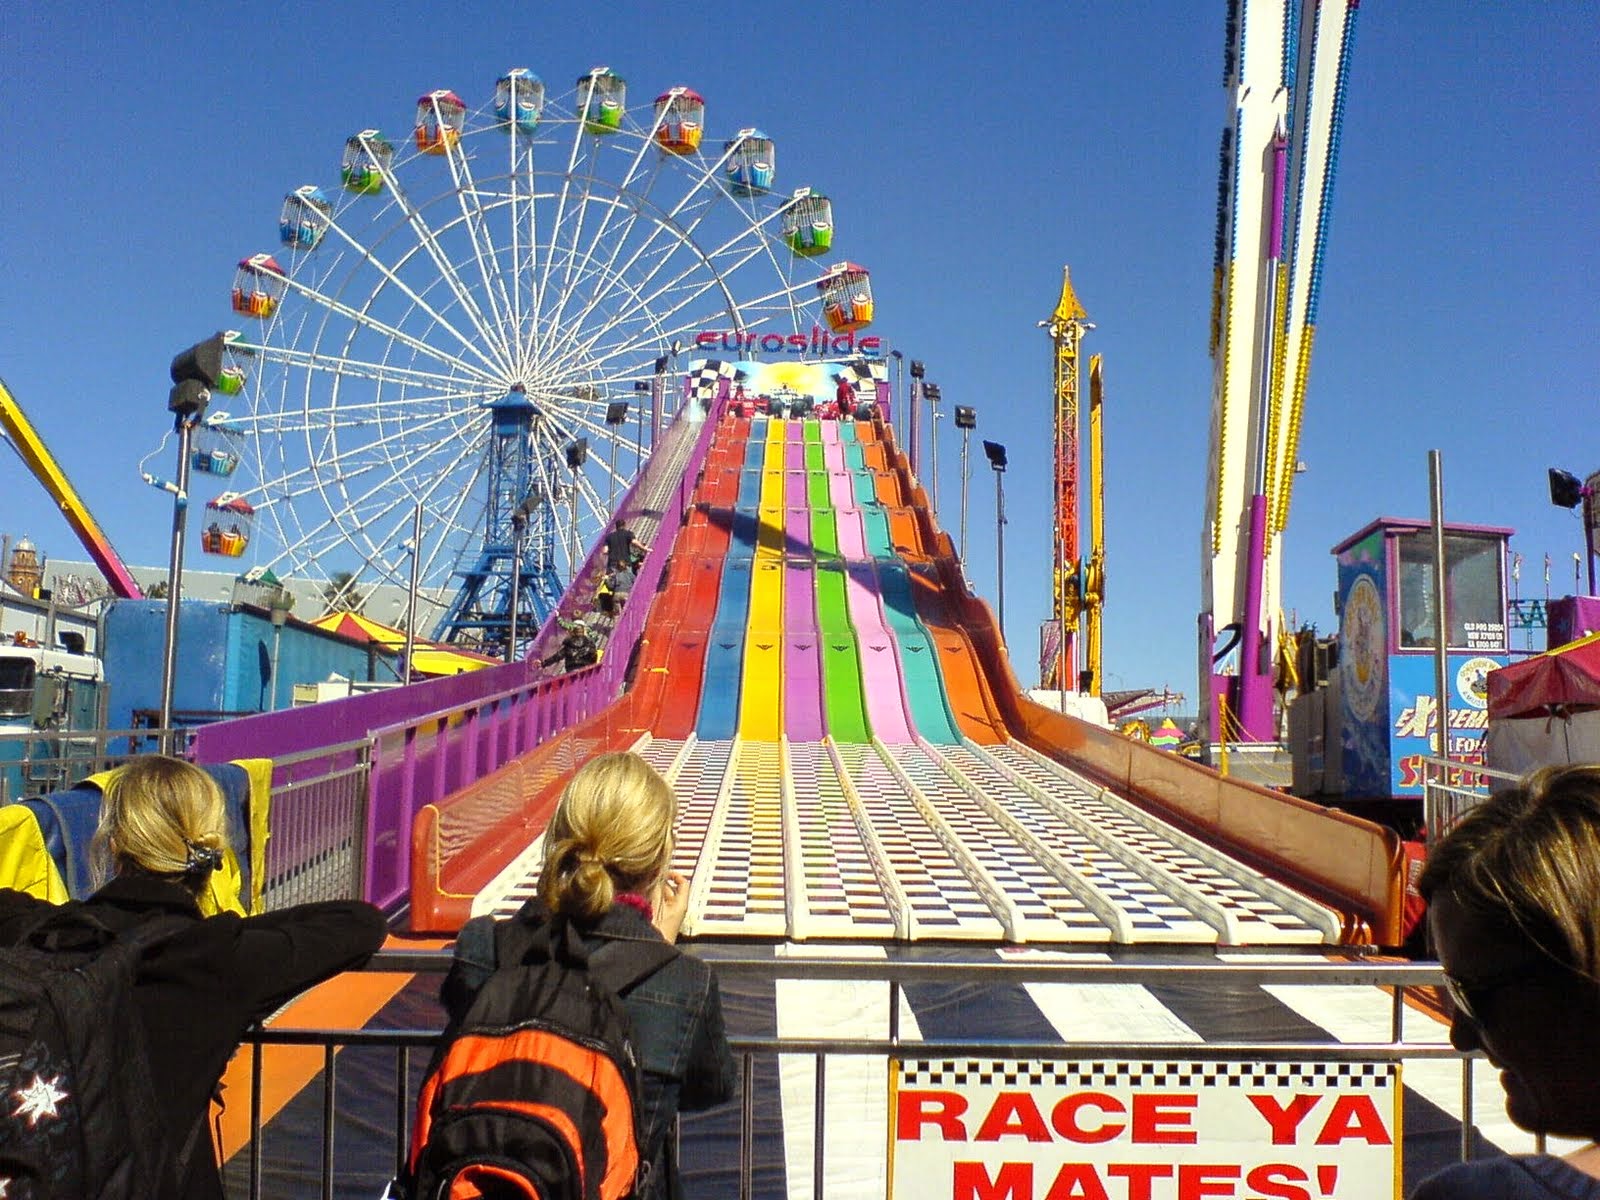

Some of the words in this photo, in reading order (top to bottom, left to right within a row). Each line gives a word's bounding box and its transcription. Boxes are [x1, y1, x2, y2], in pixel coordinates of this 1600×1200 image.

[896, 1090, 1198, 1145] RACE
[1245, 1092, 1394, 1146] YA
[952, 1160, 1339, 1200] MATES'
